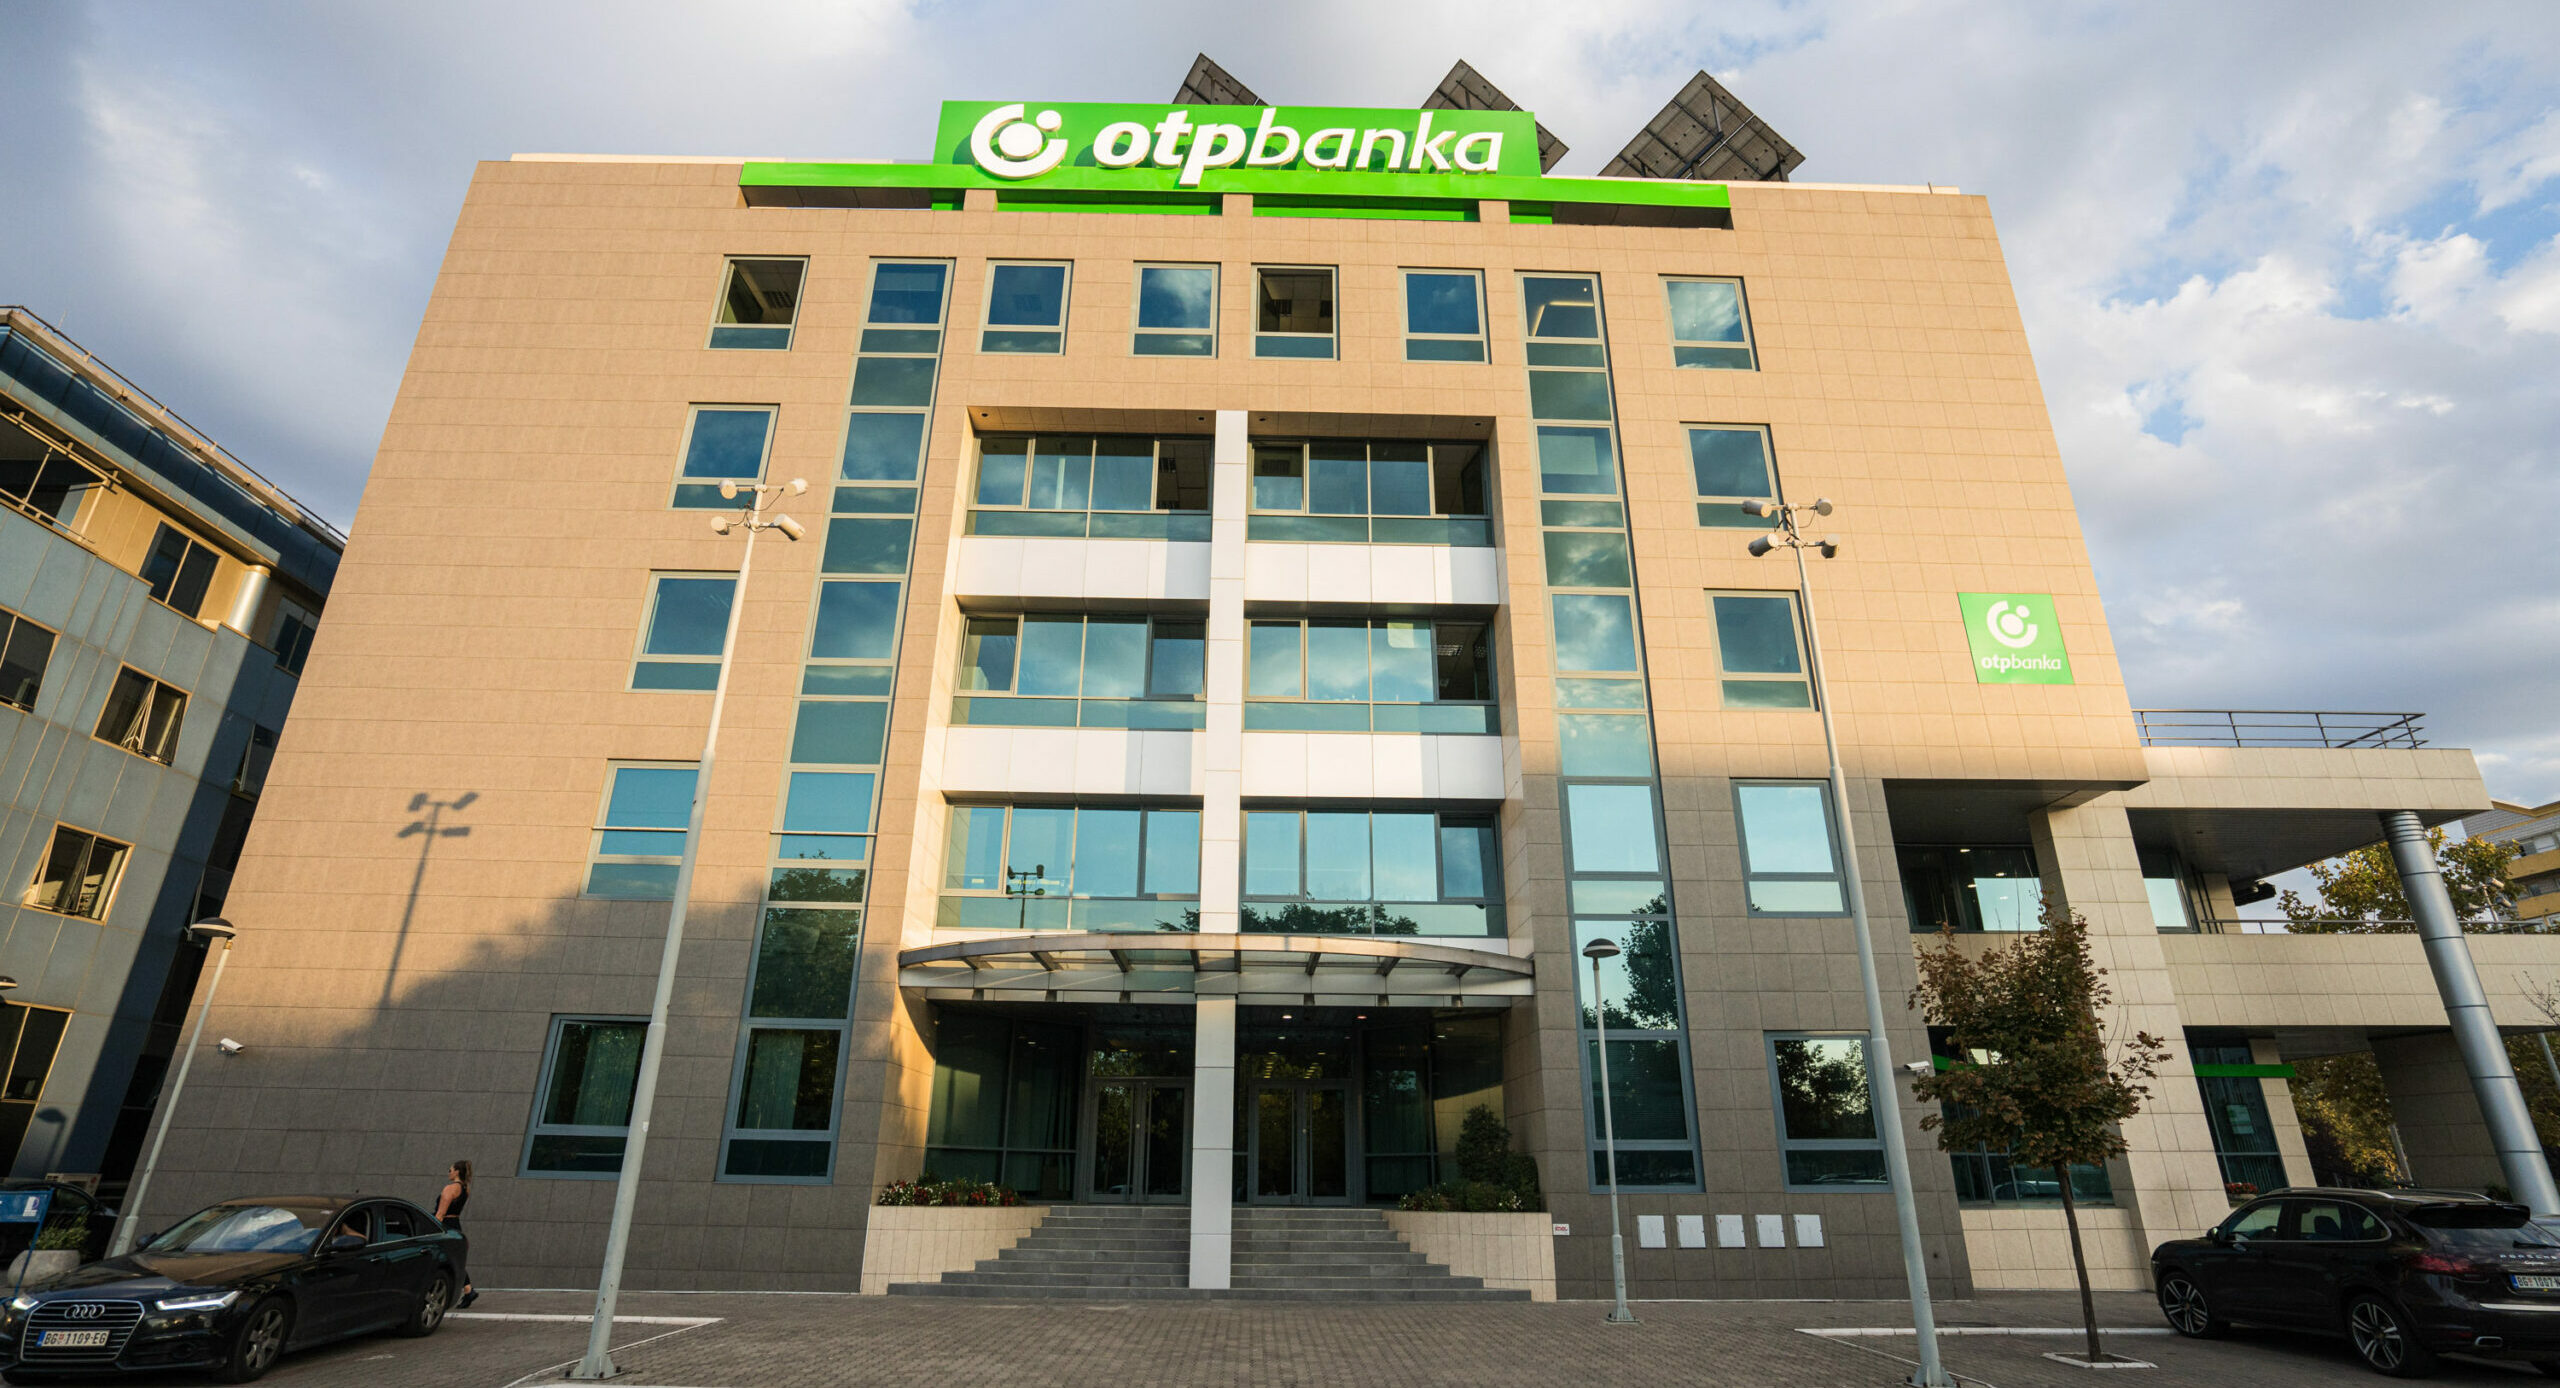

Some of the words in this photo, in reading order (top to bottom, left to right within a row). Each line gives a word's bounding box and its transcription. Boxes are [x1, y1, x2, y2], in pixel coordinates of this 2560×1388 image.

[1093, 108, 1504, 187] otpbanka
[1981, 653, 2061, 674] otpbanka
[44, 1332, 58, 1345] BG
